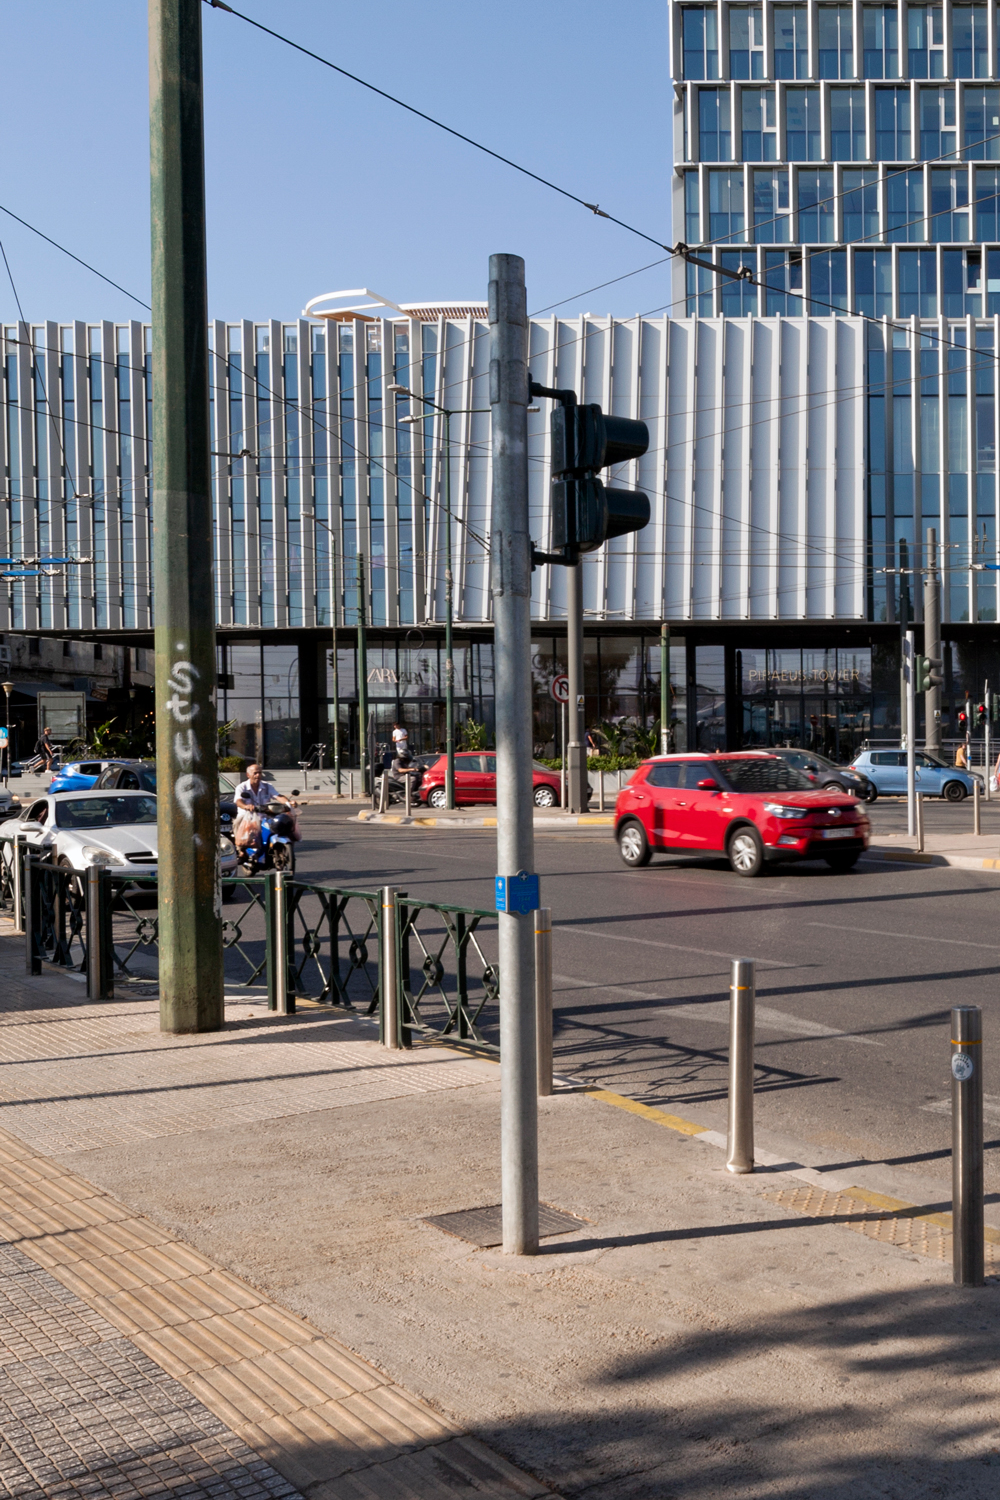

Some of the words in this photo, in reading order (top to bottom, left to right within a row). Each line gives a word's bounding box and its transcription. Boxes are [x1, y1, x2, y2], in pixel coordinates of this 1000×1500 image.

[367, 668, 398, 683] ZARA
[748, 669, 806, 681] PIRAEUS
[812, 668, 860, 681] TOWER
